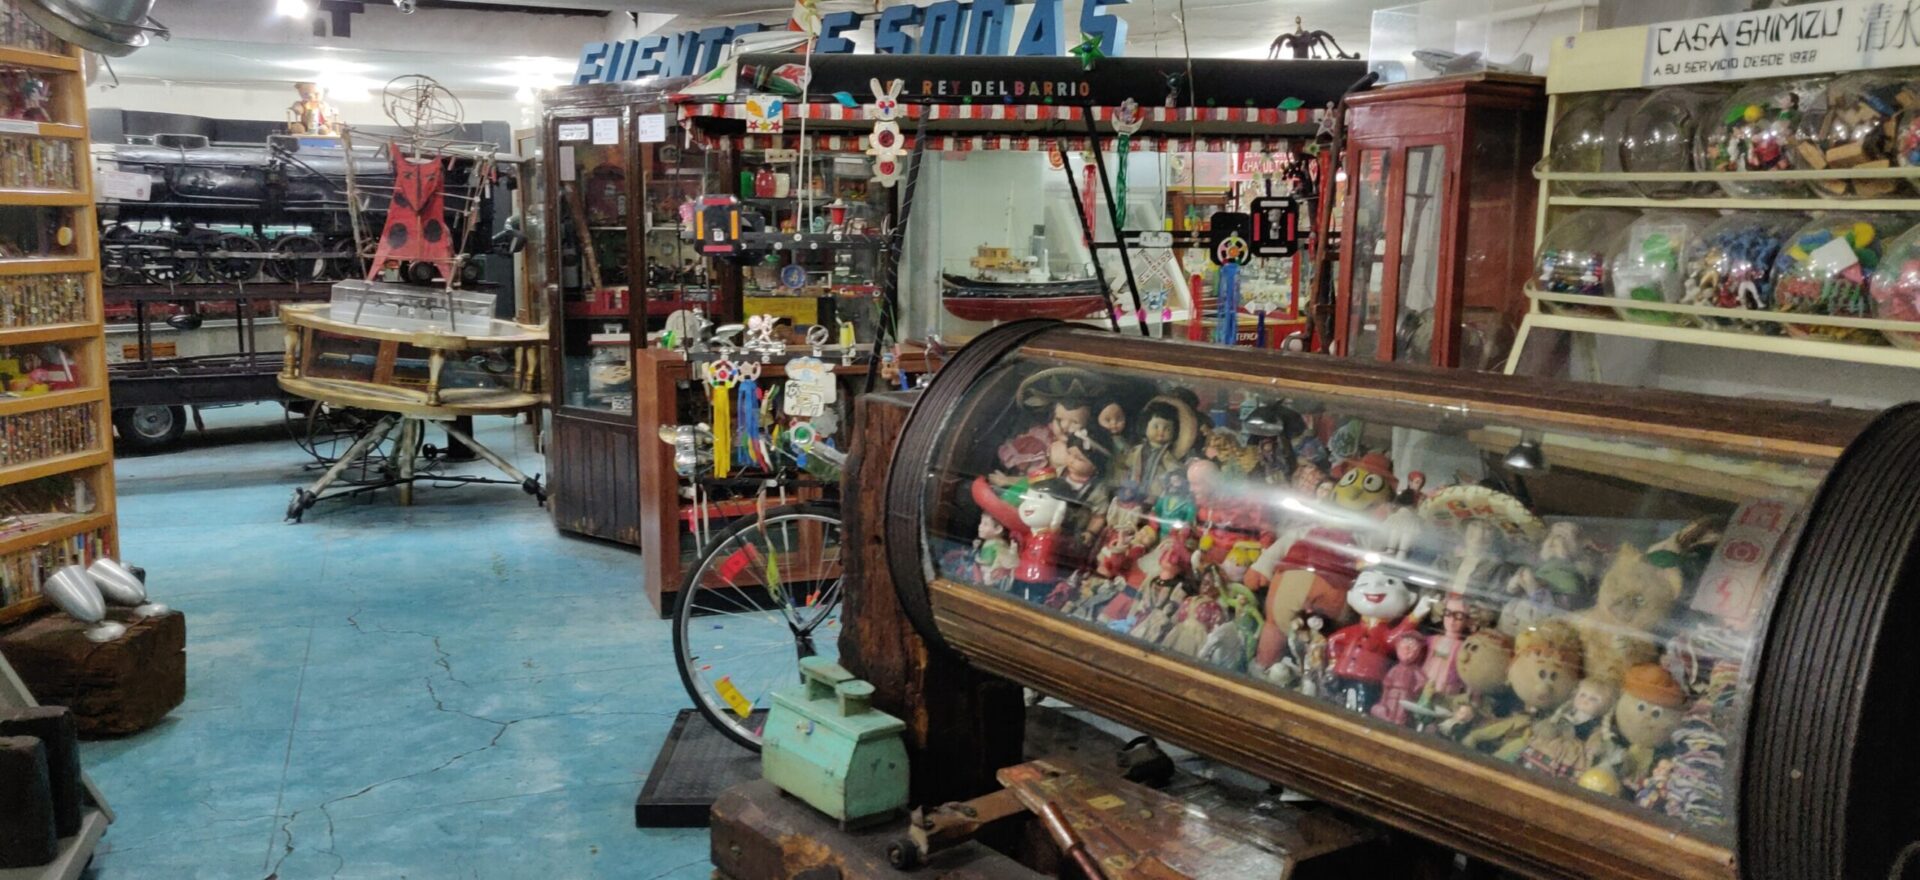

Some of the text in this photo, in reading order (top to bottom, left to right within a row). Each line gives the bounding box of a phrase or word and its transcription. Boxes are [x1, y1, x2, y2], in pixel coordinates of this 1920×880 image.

[1656, 7, 1844, 55] CASA SHIMIZU
[1653, 67, 1662, 76] A
[1684, 58, 1739, 74] SERVICIO
[1743, 53, 1785, 69] DESDE
[922, 80, 961, 96] REY
